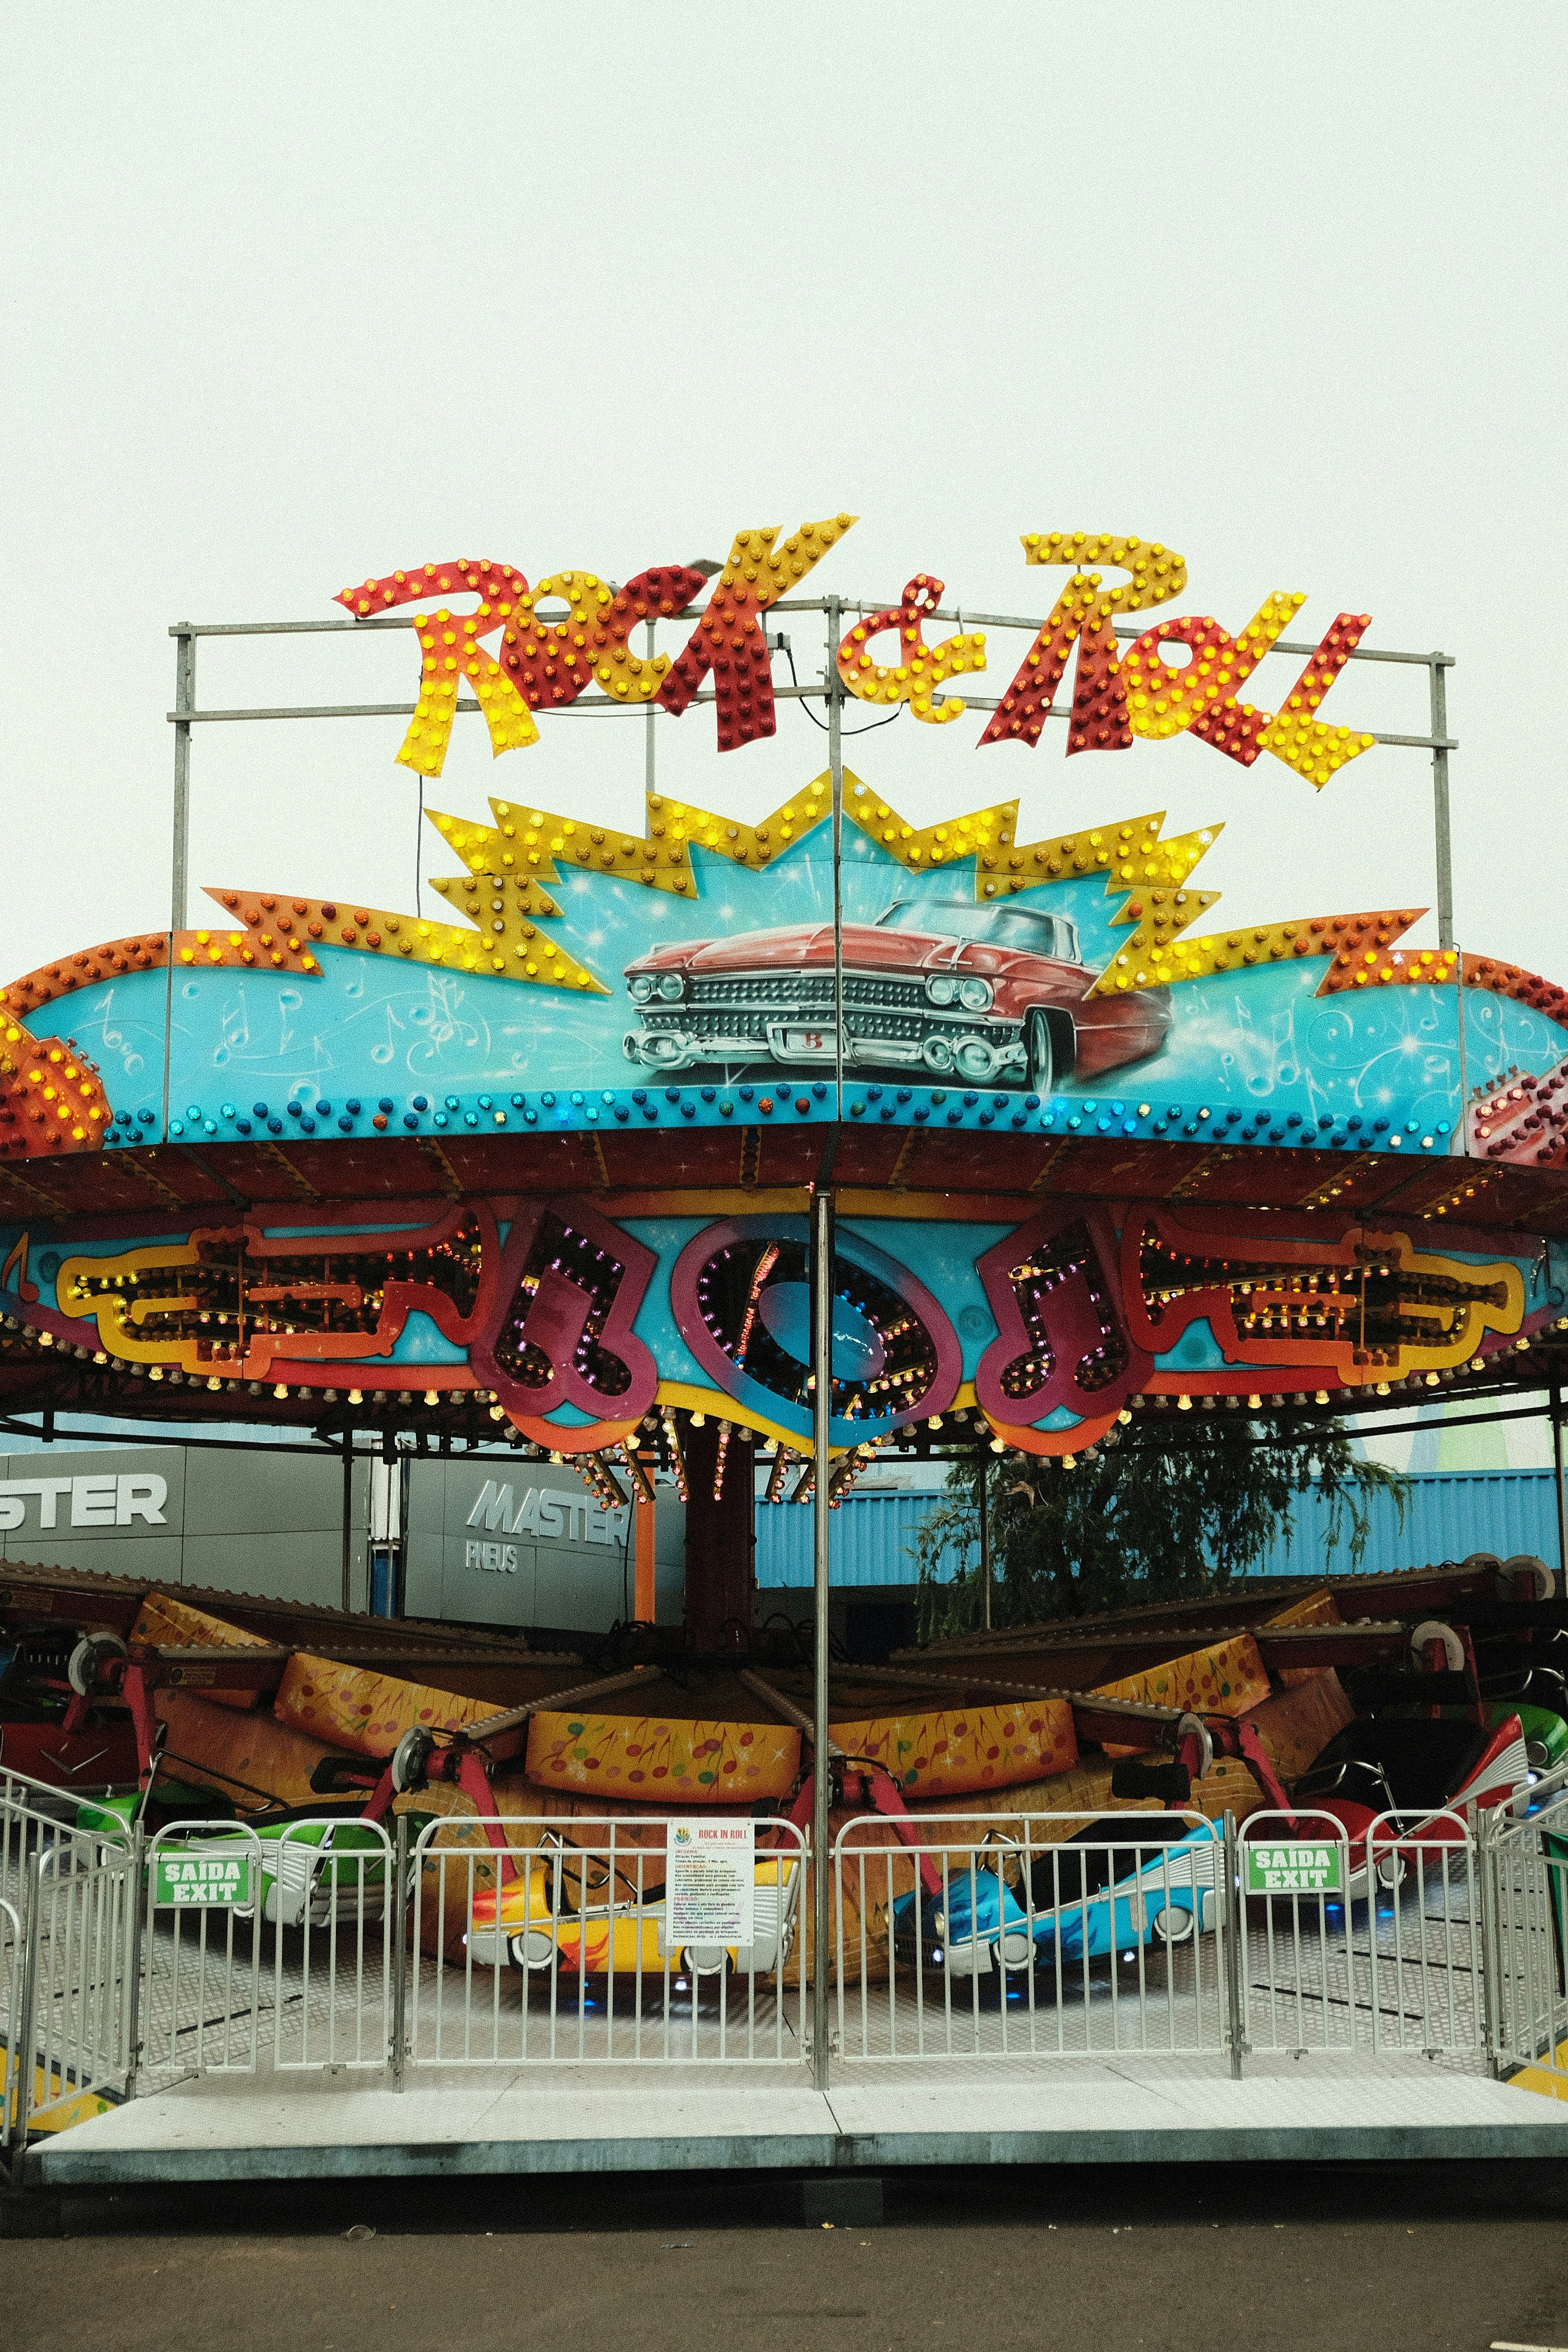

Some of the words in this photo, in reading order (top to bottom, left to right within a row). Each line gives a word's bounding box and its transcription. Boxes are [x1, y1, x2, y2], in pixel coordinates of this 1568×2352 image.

[330, 515, 860, 778] ROCK
[837, 573, 987, 724] &
[976, 533, 1379, 793] ROLL
[466, 1480, 629, 1548] MASTER
[466, 1540, 517, 1573] PNEUS
[699, 1829, 718, 1839] ROCK
[720, 1829, 728, 1839] IN
[730, 1829, 747, 1839] ROLL
[1265, 1869, 1327, 1888] EXIT
[173, 1882, 237, 1902] EXIT
